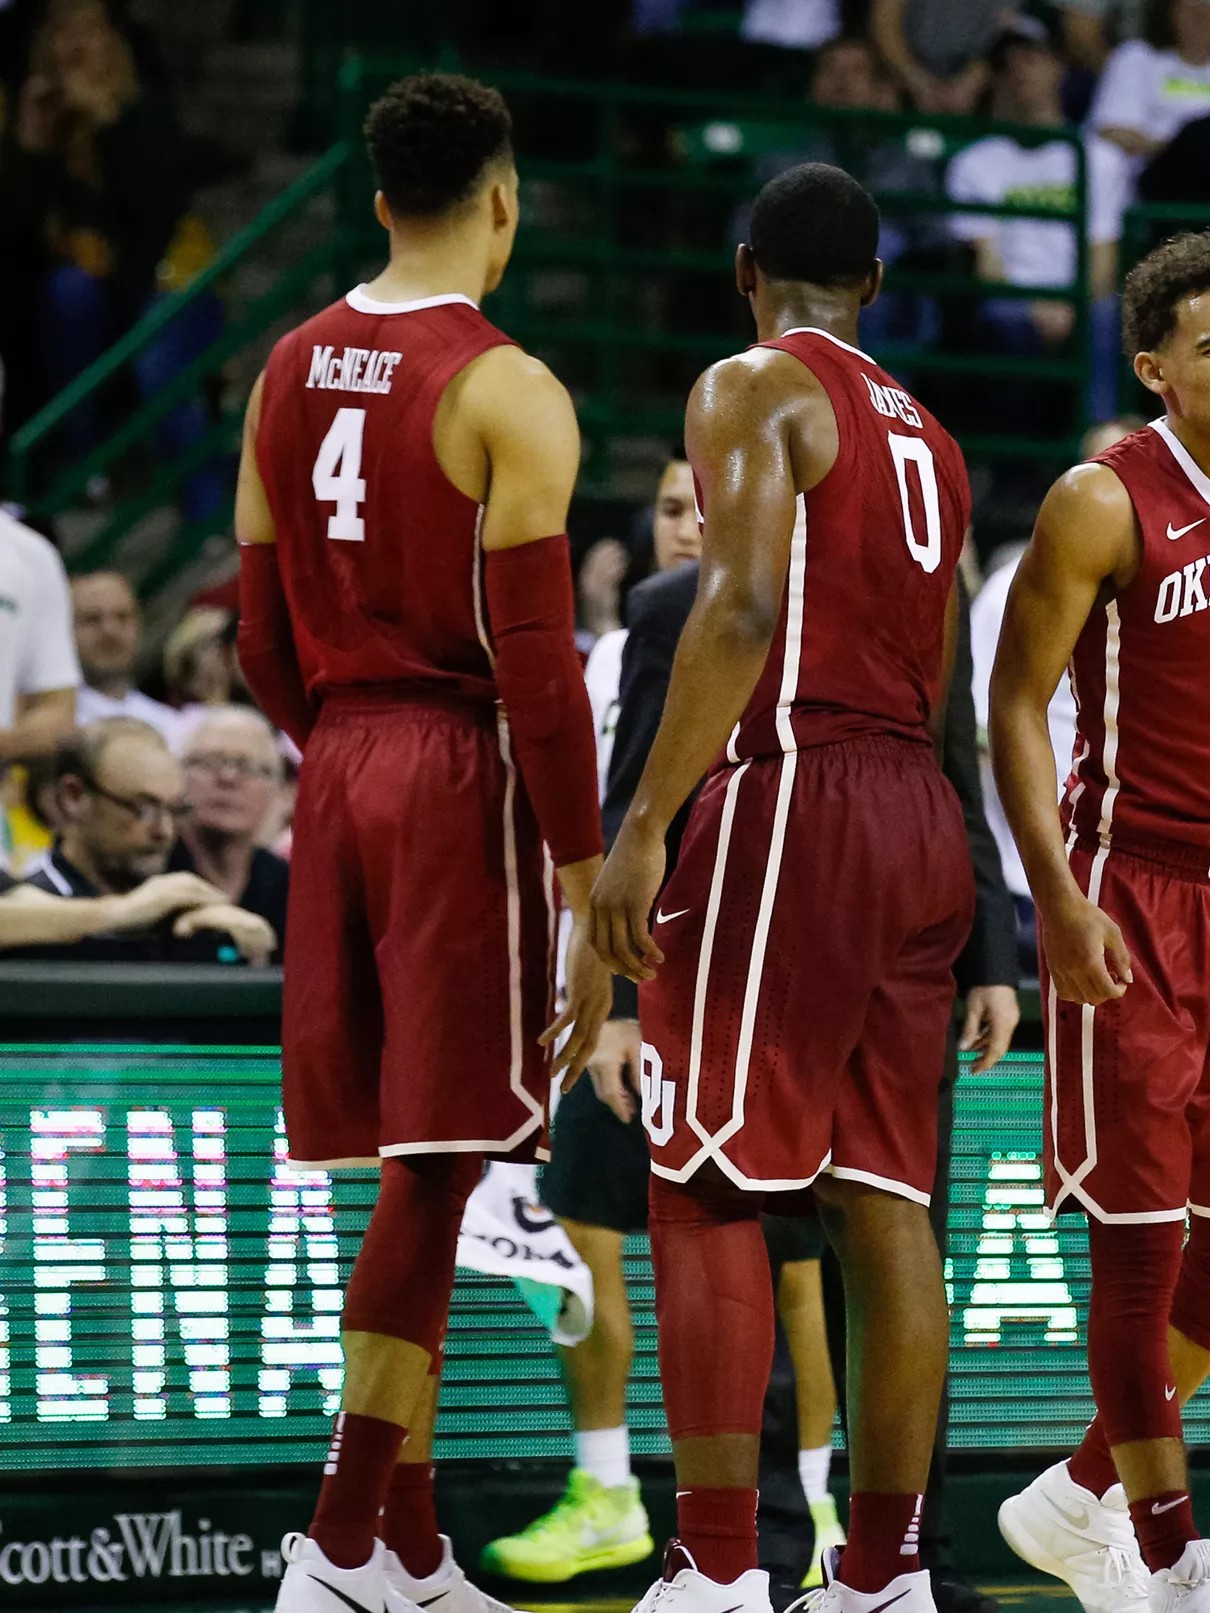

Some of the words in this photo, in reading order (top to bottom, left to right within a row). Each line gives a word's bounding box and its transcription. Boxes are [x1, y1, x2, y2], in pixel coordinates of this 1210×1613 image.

[305, 345, 403, 394] McNEACE
[312, 407, 367, 542] 4
[887, 429, 942, 575] 0
[0, 1108, 345, 1423] ENA
[0, 1509, 255, 1585] cott&White
